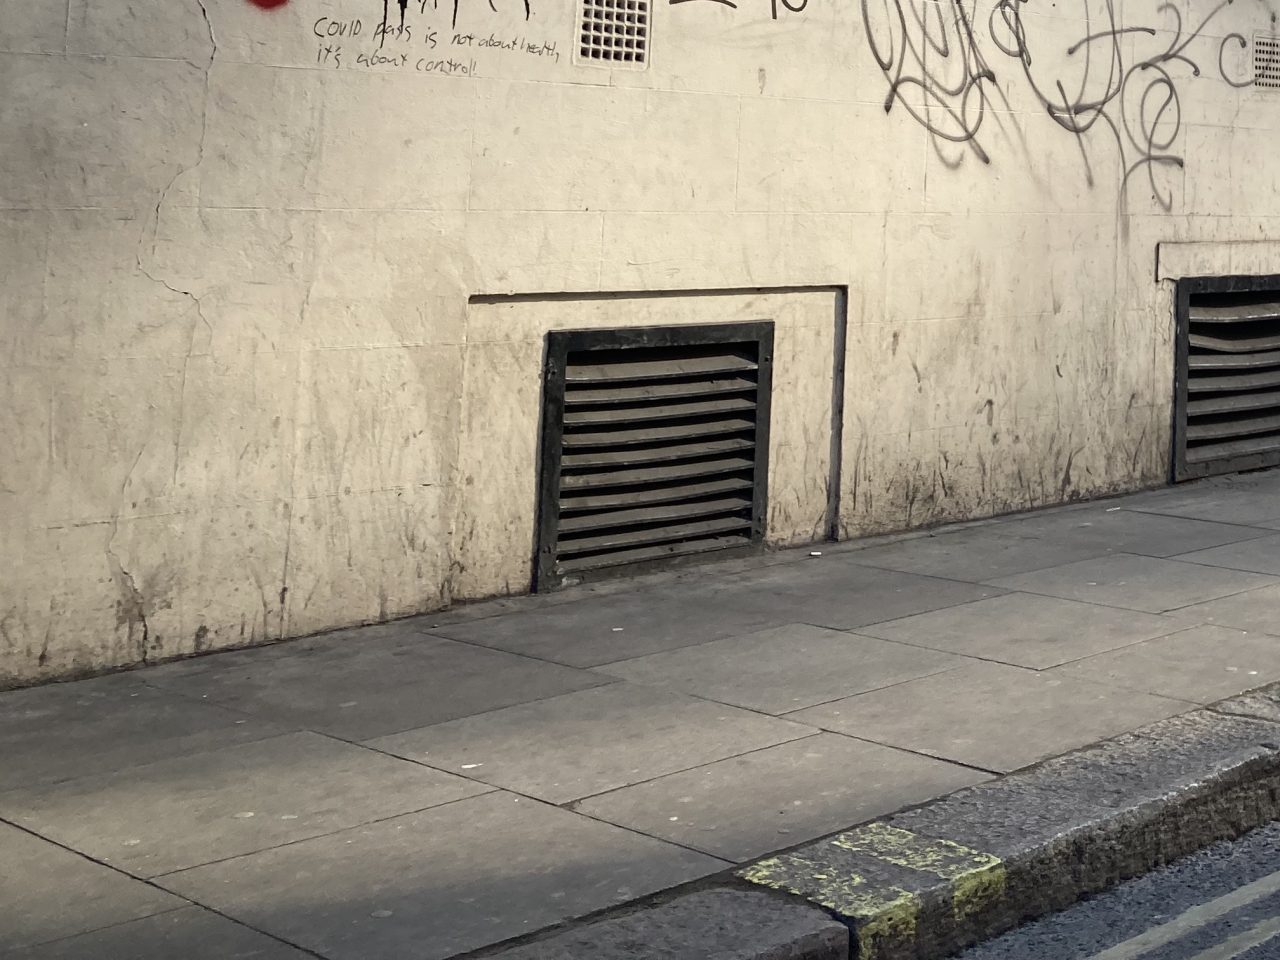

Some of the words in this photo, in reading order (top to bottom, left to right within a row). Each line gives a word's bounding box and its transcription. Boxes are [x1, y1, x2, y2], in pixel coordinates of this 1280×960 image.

[313, 16, 362, 38] COVID
[372, 22, 412, 42] pass
[424, 26, 438, 49] is
[451, 33, 475, 47] not
[478, 33, 518, 51] about
[317, 43, 342, 69] it's
[356, 49, 408, 68] about
